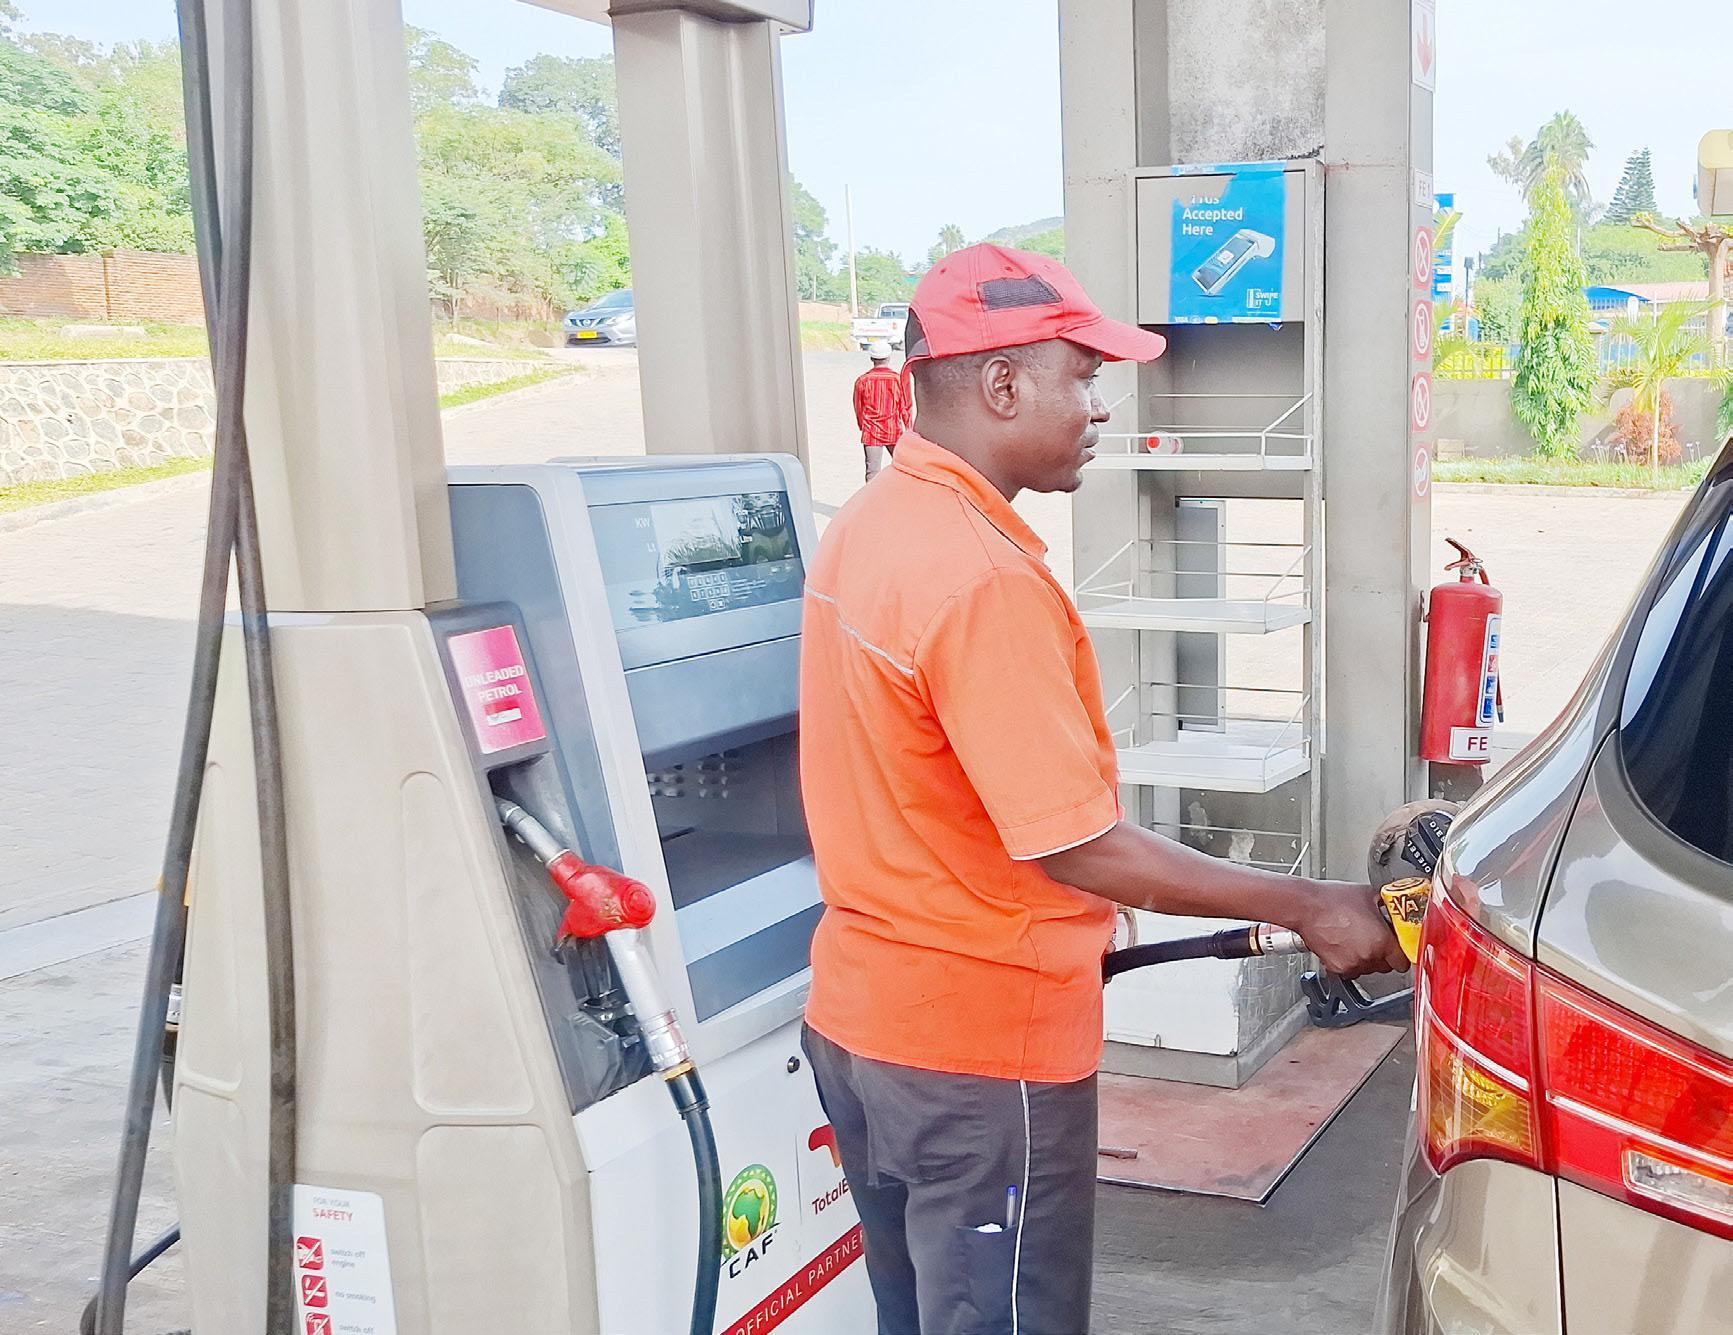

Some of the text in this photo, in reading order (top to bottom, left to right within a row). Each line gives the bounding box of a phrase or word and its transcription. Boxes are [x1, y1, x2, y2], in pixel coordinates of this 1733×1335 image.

[1182, 208, 1243, 222] Accepted
[1182, 224, 1213, 235] Here
[465, 666, 524, 687] UNLEADED
[479, 684, 523, 701] PETROL
[1467, 736, 1489, 751] FE
[1407, 840, 1432, 873] DIESEL
[312, 1208, 353, 1222] SAFETY
[729, 1232, 773, 1279] CAF
